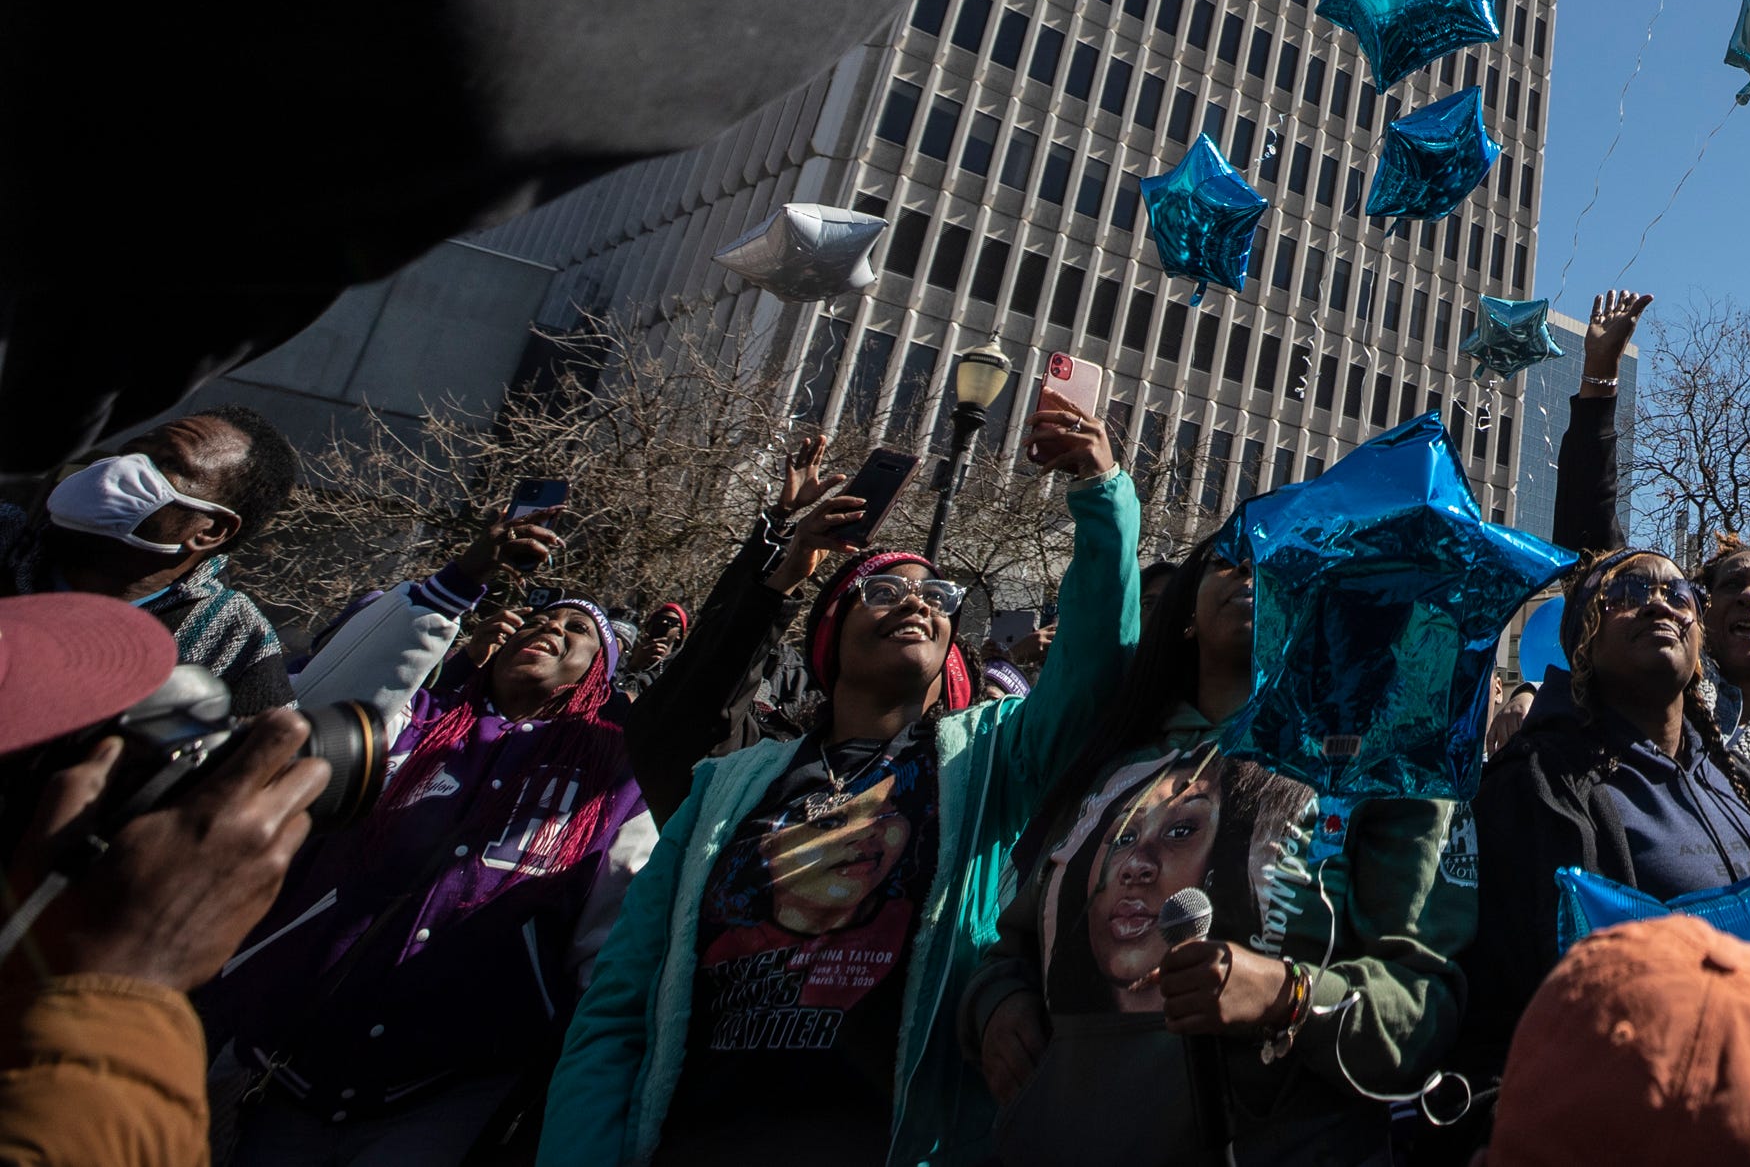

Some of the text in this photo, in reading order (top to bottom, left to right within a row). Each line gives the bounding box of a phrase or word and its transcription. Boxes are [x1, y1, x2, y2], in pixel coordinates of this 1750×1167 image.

[790, 949, 893, 966] BRENNA TAYLOR
[808, 976, 834, 986] March
[852, 977, 876, 987] 2020
